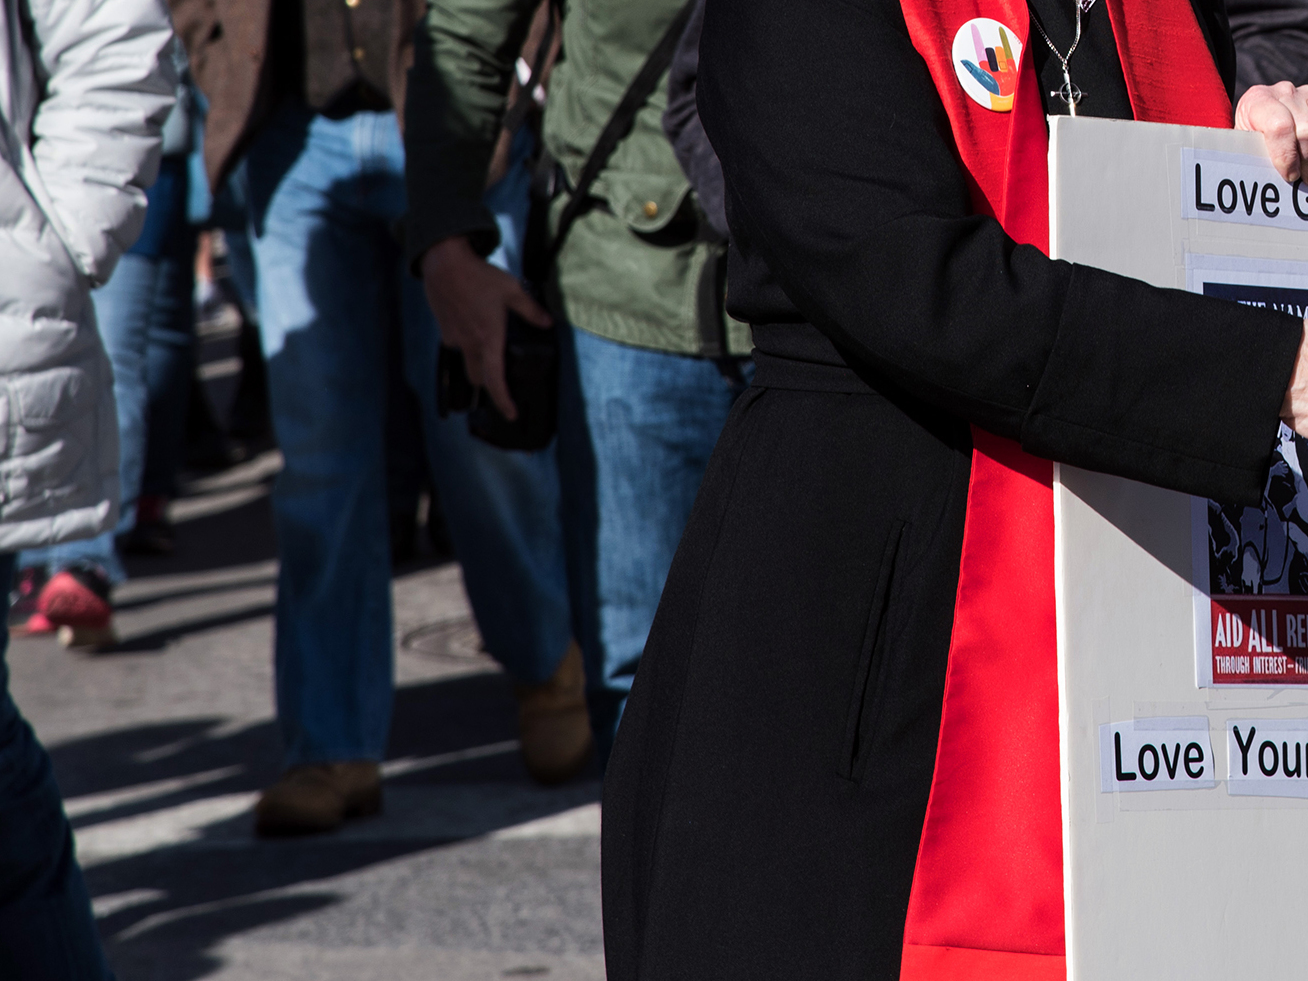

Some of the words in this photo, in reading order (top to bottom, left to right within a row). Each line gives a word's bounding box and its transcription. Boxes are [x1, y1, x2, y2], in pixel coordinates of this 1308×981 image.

[1195, 162, 1280, 218] Love
[1214, 612, 1243, 648] AID
[1247, 608, 1284, 653] ALL
[1215, 655, 1250, 675] THROUGH
[1114, 731, 1204, 782] Love
